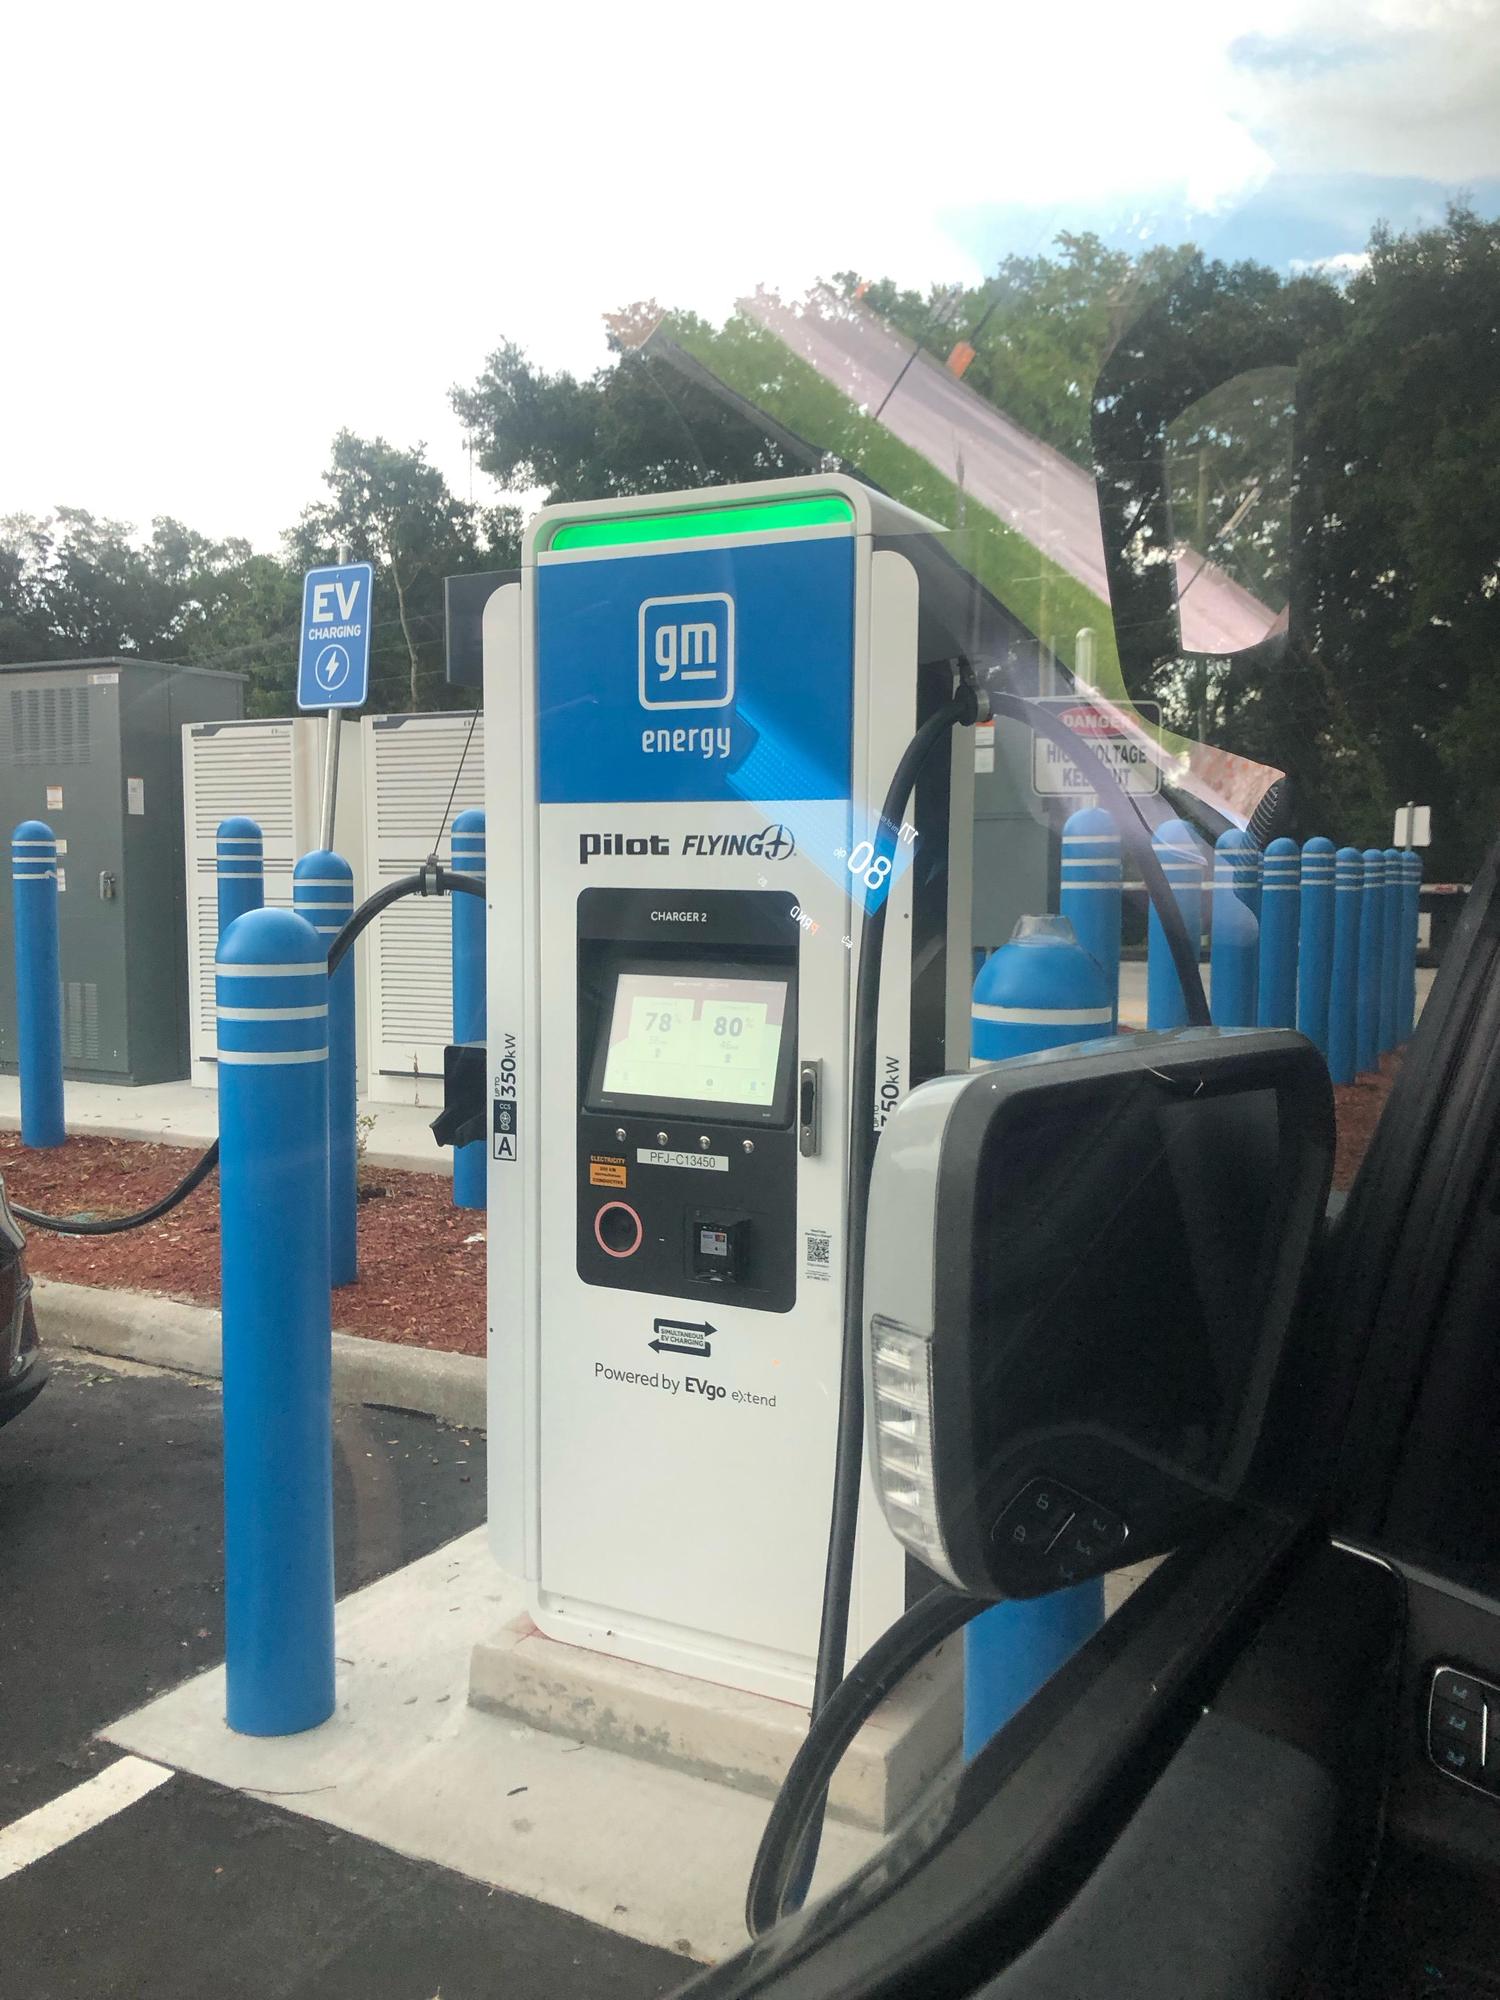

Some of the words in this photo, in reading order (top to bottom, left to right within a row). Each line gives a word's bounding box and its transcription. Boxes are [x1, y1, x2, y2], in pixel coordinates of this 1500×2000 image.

[312, 580, 360, 623] EV
[308, 624, 361, 641] CHARGING
[655, 622, 717, 682] gm
[1063, 713, 1132, 729] DANGE
[641, 727, 731, 759] energy
[579, 833, 670, 865] pilot
[682, 833, 764, 856] FLYING
[650, 911, 699, 922] CHARGER
[700, 912, 708, 922] 2
[645, 1012, 672, 1033] 78
[713, 1016, 743, 1037] 80
[501, 1033, 516, 1098] 350kW
[498, 1136, 513, 1156] A
[649, 1151, 716, 1168] PFJ-C13450
[660, 1327, 704, 1341] SIMULTANEOUS
[660, 1334, 670, 1342] EV
[670, 1336, 704, 1347] CHARGING
[594, 1361, 659, 1388] Powered
[661, 1373, 681, 1395] by
[685, 1376, 727, 1401] EVgo
